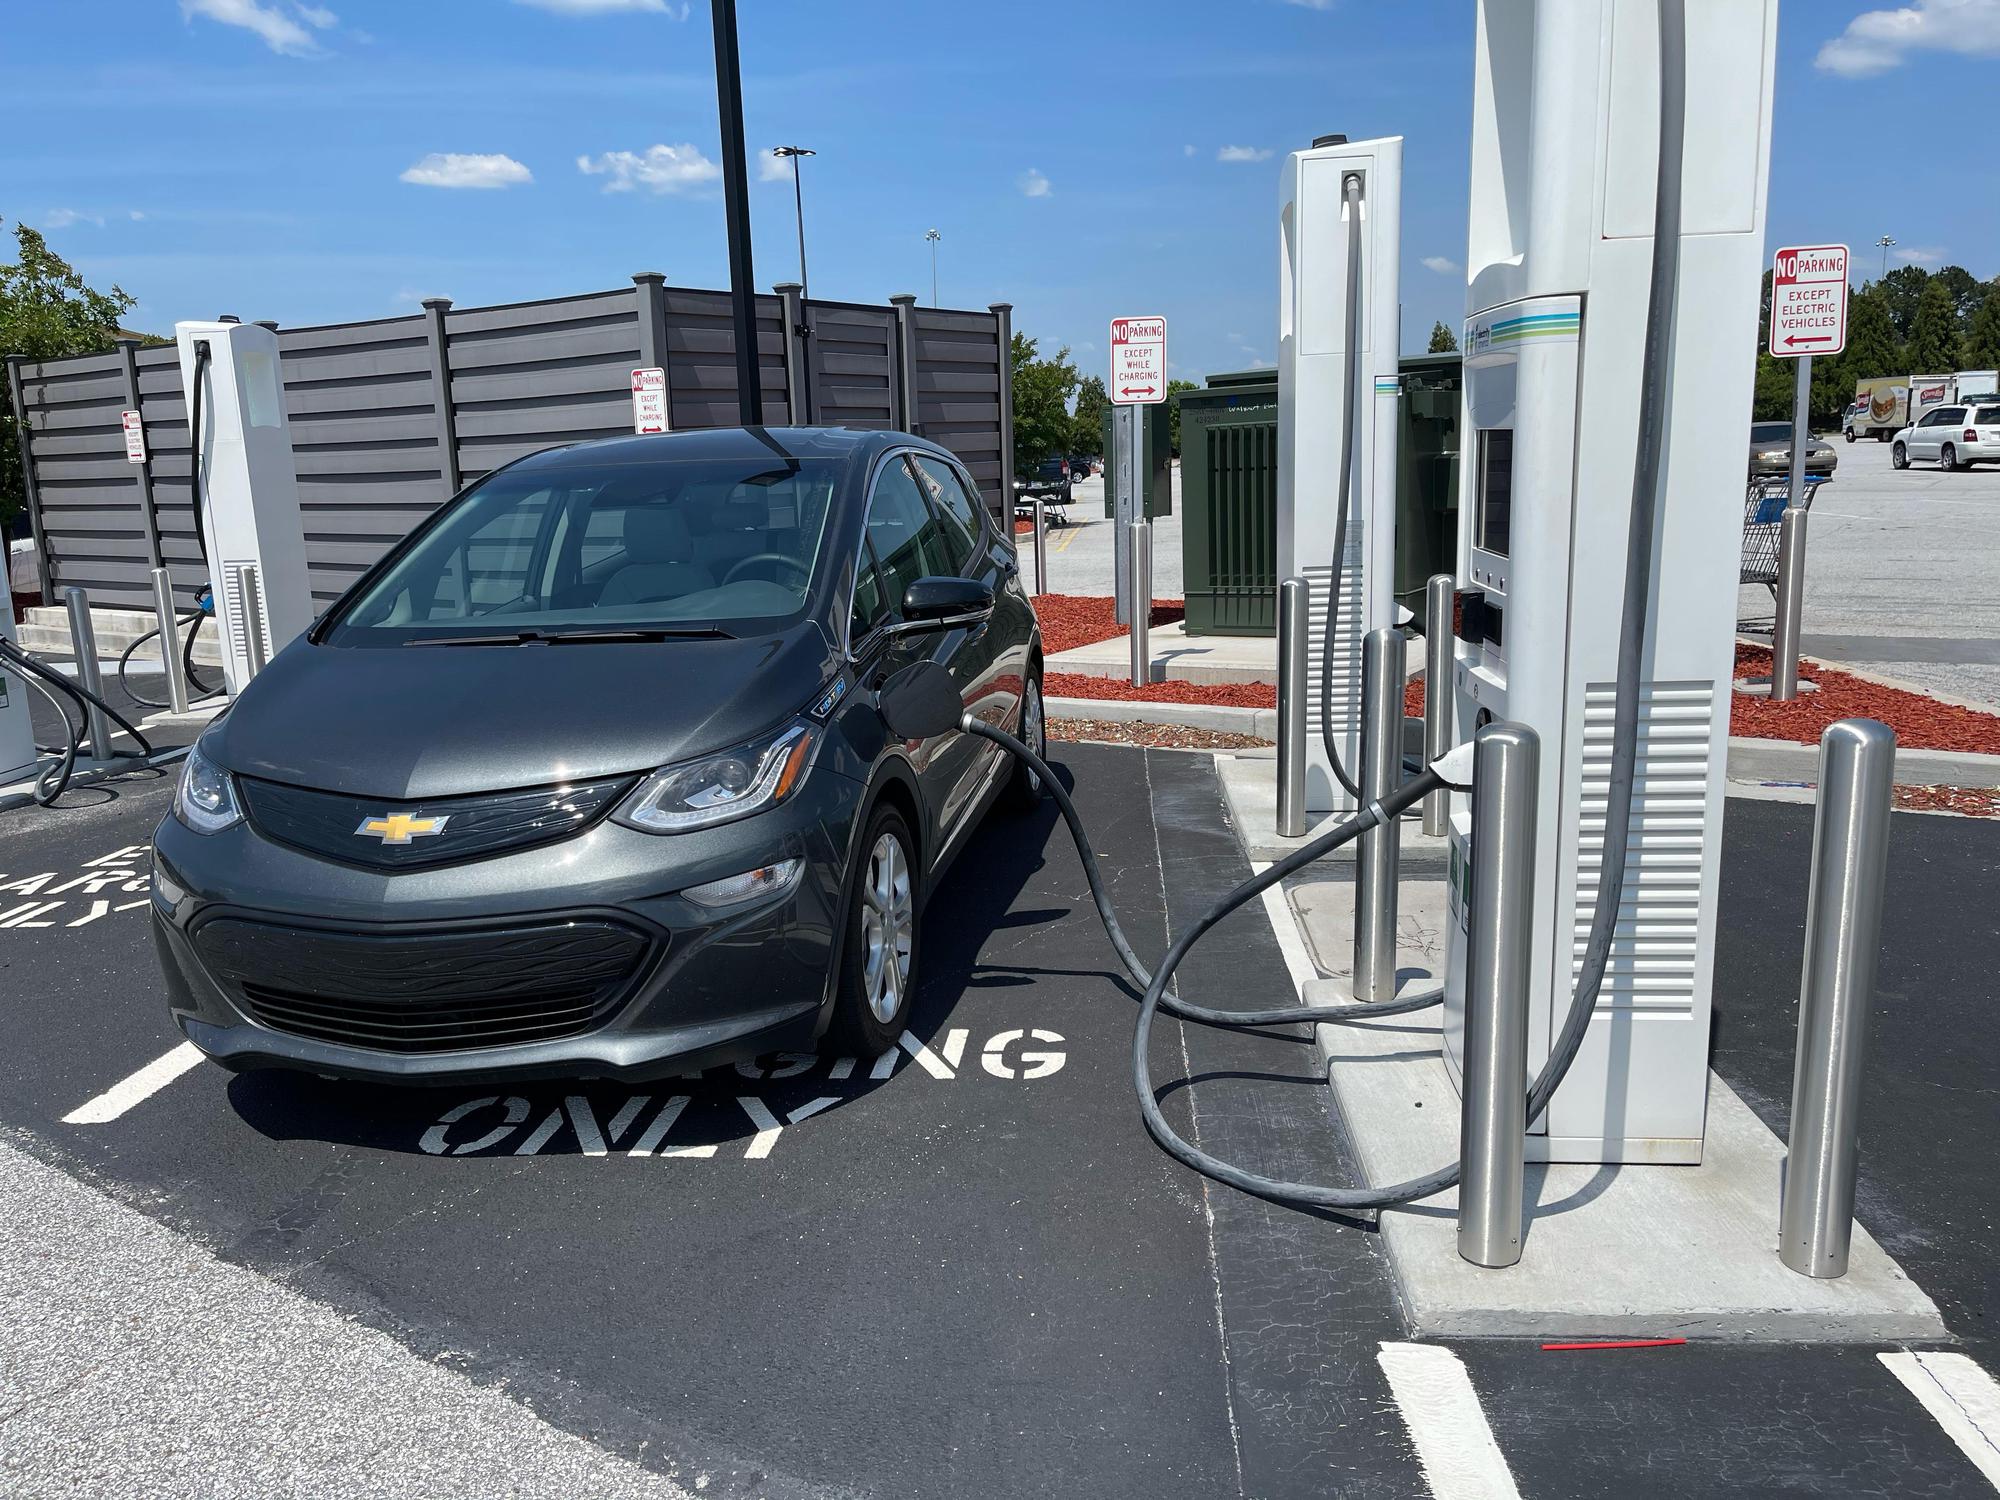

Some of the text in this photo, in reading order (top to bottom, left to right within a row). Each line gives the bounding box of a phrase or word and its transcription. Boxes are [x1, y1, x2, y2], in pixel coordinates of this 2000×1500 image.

[1776, 257, 1843, 278] NO PARKING
[1789, 289, 1831, 301] EXCEPT
[1782, 303, 1836, 315] ELECTRIC
[1781, 317, 1836, 329] VEHICLES
[1113, 324, 1162, 340] NO PARKING
[1124, 349, 1153, 358] EXCEPT
[1127, 360, 1150, 369] WHILE
[633, 375, 663, 388] NO PARKING
[1119, 371, 1158, 381] CHARGING
[640, 413, 663, 421] CHARGING
[418, 1095, 844, 1159] ONLY
